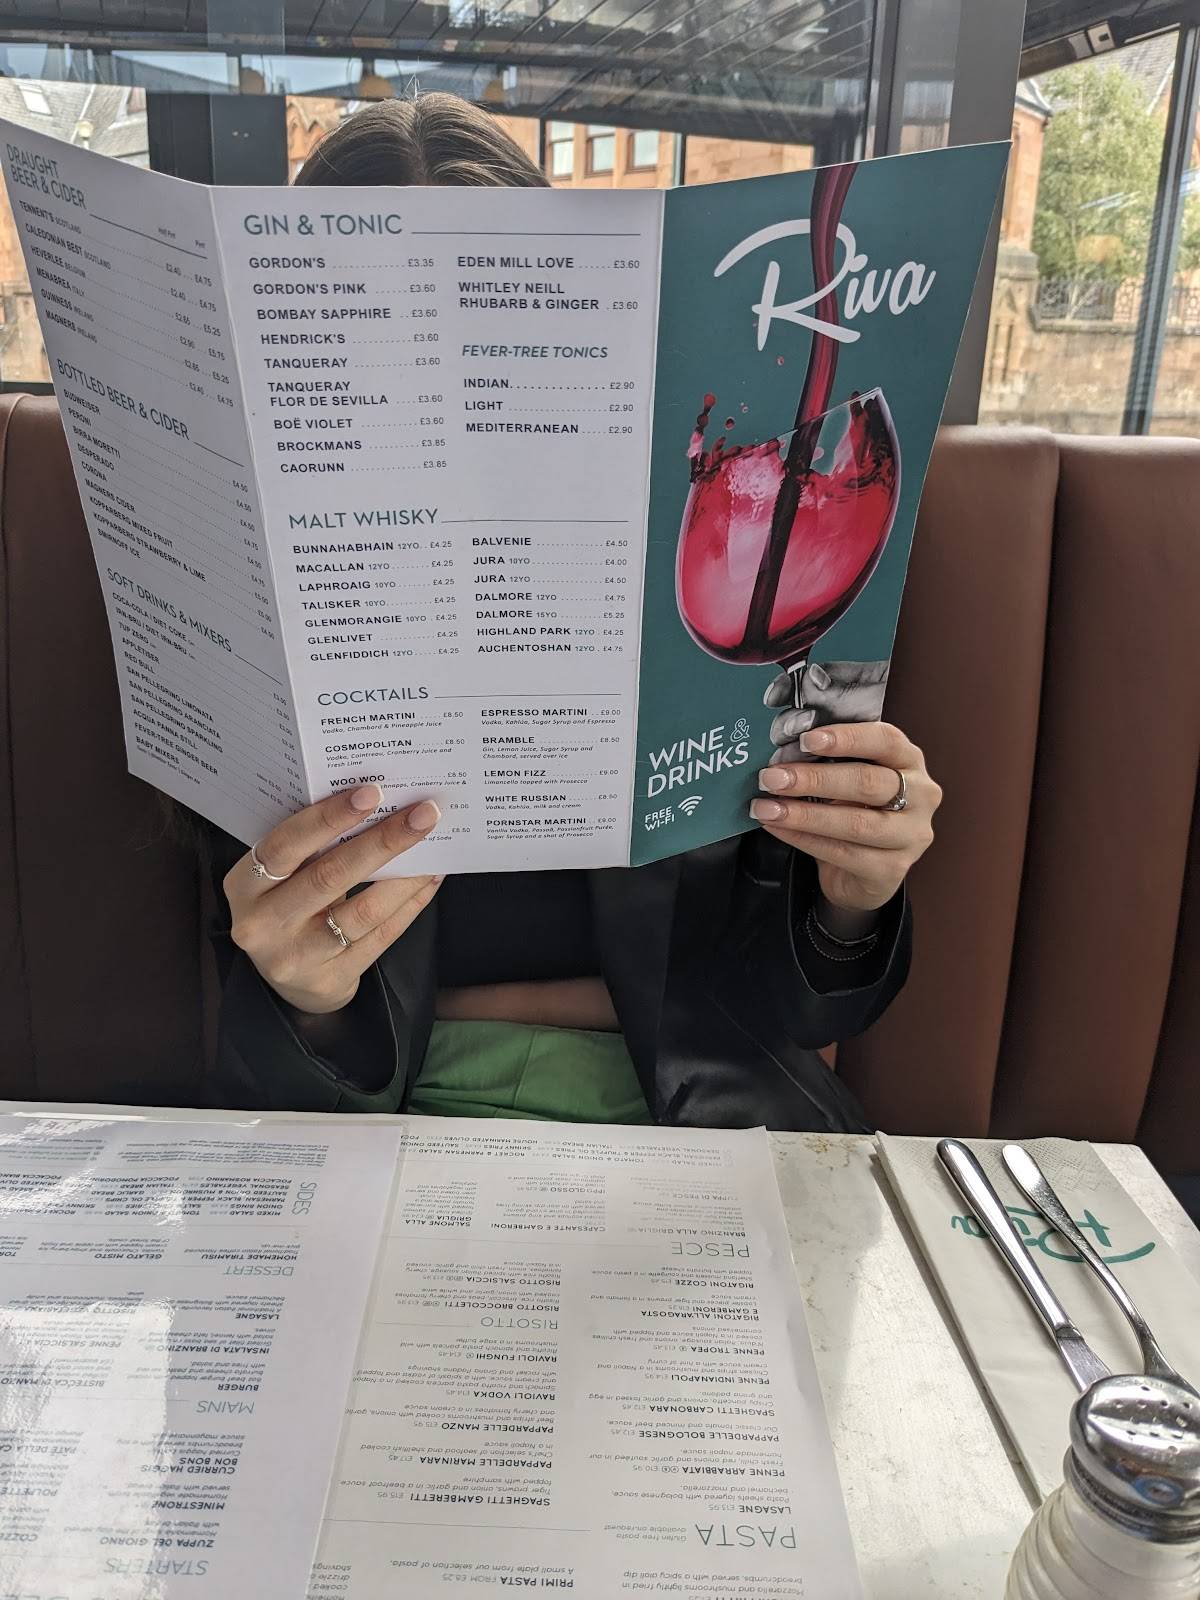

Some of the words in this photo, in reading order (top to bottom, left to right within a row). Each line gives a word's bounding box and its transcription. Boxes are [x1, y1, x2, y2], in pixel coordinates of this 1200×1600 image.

[6, 143, 59, 178] DRAUGHT
[10, 164, 40, 191] BEER
[40, 176, 51, 195] &
[50, 180, 87, 210] CIDER
[244, 214, 289, 235] GIN
[297, 214, 315, 235] &
[320, 214, 402, 235] TONIC
[249, 257, 325, 269] GORDON'S
[408, 258, 434, 267] £3.35
[458, 256, 495, 267] EDEN
[500, 257, 533, 268] MILL
[537, 257, 574, 268] LOVE
[613, 260, 640, 269] £3.60
[253, 283, 329, 295] GORDON'S
[333, 283, 366, 294] PINK
[409, 284, 436, 293] £3.60
[458, 282, 520, 293] WHITLEY
[525, 283, 565, 294] NEILL
[714, 218, 936, 351] Riva
[460, 297, 528, 309] RHUBARB
[532, 298, 541, 309] &
[545, 299, 599, 310] GINGER
[612, 301, 638, 310] £3.60
[257, 309, 316, 320] BOMBAY
[321, 308, 391, 319] SAPPHIRE
[411, 308, 438, 318] £3.60
[261, 334, 345, 344] HENDRICK'S
[414, 333, 439, 342] £3.60
[462, 345, 549, 358] FEVER-TREE
[553, 346, 608, 358] TONICS
[264, 358, 348, 369] TANQUERAY
[415, 357, 440, 366] £3.60
[267, 381, 350, 392] TANQUERAY
[464, 378, 509, 388] INDIAN
[609, 381, 635, 390] £2.90
[57, 358, 106, 397] BOTTLED
[106, 385, 136, 415] BEER
[139, 402, 148, 420] &
[150, 408, 190, 440] CIDER
[63, 388, 101, 414] BUDWEISER
[270, 397, 305, 407] FLOR
[309, 396, 328, 406] DE
[332, 395, 388, 406] SEVILLA
[418, 394, 443, 403] £3.60
[465, 401, 504, 410] LIGHT
[609, 404, 634, 412] £2.90
[67, 407, 92, 427] PERONI
[274, 417, 302, 429] BOË
[305, 418, 353, 429] VIOLET
[420, 417, 444, 425] £3.60
[466, 423, 578, 433] MEDITERRANEAN
[608, 426, 633, 434] £2.90
[277, 440, 362, 451] BROCKMANS
[421, 438, 446, 447] £3.85
[77, 443, 115, 471] DESPERADO
[280, 463, 344, 473] CAORUNN
[423, 460, 447, 469] £3.85
[289, 512, 347, 529] MALT
[353, 508, 438, 527] WHISKY
[472, 537, 531, 546] BALVENIE
[293, 542, 393, 554] BUNNAHABHAIN
[397, 542, 419, 550] 12YO
[473, 556, 505, 565] JURA
[296, 562, 364, 573] MACALLAN
[474, 574, 506, 583] JURA
[299, 581, 371, 592] LAPHROAIG
[475, 592, 532, 601] DALMORE
[107, 567, 134, 592] SOFT
[137, 585, 177, 618] DRINKS
[179, 610, 187, 624] &
[188, 617, 232, 652] MIXERS
[301, 600, 361, 610] TALISKER
[476, 610, 533, 619] DALMORE
[305, 615, 402, 628] GLENMORANGIE
[477, 627, 536, 636] HIGHLAND
[540, 627, 571, 635] PARK
[308, 634, 372, 645] GLENLIVET
[478, 644, 571, 653] AUCHENTOSHAN
[310, 650, 389, 661] GLENFIDDICH
[317, 687, 429, 706] COCKTAILS
[321, 715, 366, 726] FRENCH
[369, 712, 415, 721] MARTINI
[481, 709, 539, 717] ESPRESSO
[347, 724, 382, 732] Chambord
[325, 739, 412, 753] COSMOPOLITAN
[649, 726, 725, 771] WINE
[730, 718, 750, 742] &
[647, 742, 749, 798] DRINKS
[330, 777, 356, 787] WOO
[359, 775, 385, 783] WOO
[645, 806, 672, 823] FREE
[645, 814, 674, 831] WI-FI
[292, 1182, 317, 1216] SIDES
[951, 1204, 1156, 1265] Ria
[672, 1242, 750, 1258] PESCE
[223, 1265, 294, 1277] DESSERT
[480, 1316, 558, 1330] RISOTTO
[691, 1346, 730, 1354] TROPEA
[671, 1374, 735, 1383] INDIANAPOLI
[738, 1377, 770, 1385] PENNE
[217, 1383, 259, 1391] BURGER
[473, 1391, 511, 1399] VODKA
[514, 1392, 555, 1401] RAVIOLI
[196, 1400, 255, 1414] MAINS
[649, 1405, 714, 1413] CARBONARA
[717, 1407, 775, 1417] SPAGHETTI
[639, 1430, 705, 1439] BOLOGNESE
[709, 1432, 779, 1442] PAPPARDELLE
[420, 1456, 476, 1466] MARINARA
[480, 1458, 552, 1469] PAPPARDELLE
[682, 1466, 745, 1475] ARRABBIATA
[749, 1468, 785, 1477] PENNE
[410, 1493, 484, 1504] GAMBERETTI
[487, 1496, 550, 1506] SPAGHETTI
[739, 1505, 791, 1514] LASAGNE
[695, 1524, 796, 1549] PASTA
[500, 1576, 537, 1586] PASTA
[541, 1578, 573, 1588] PRIMI
